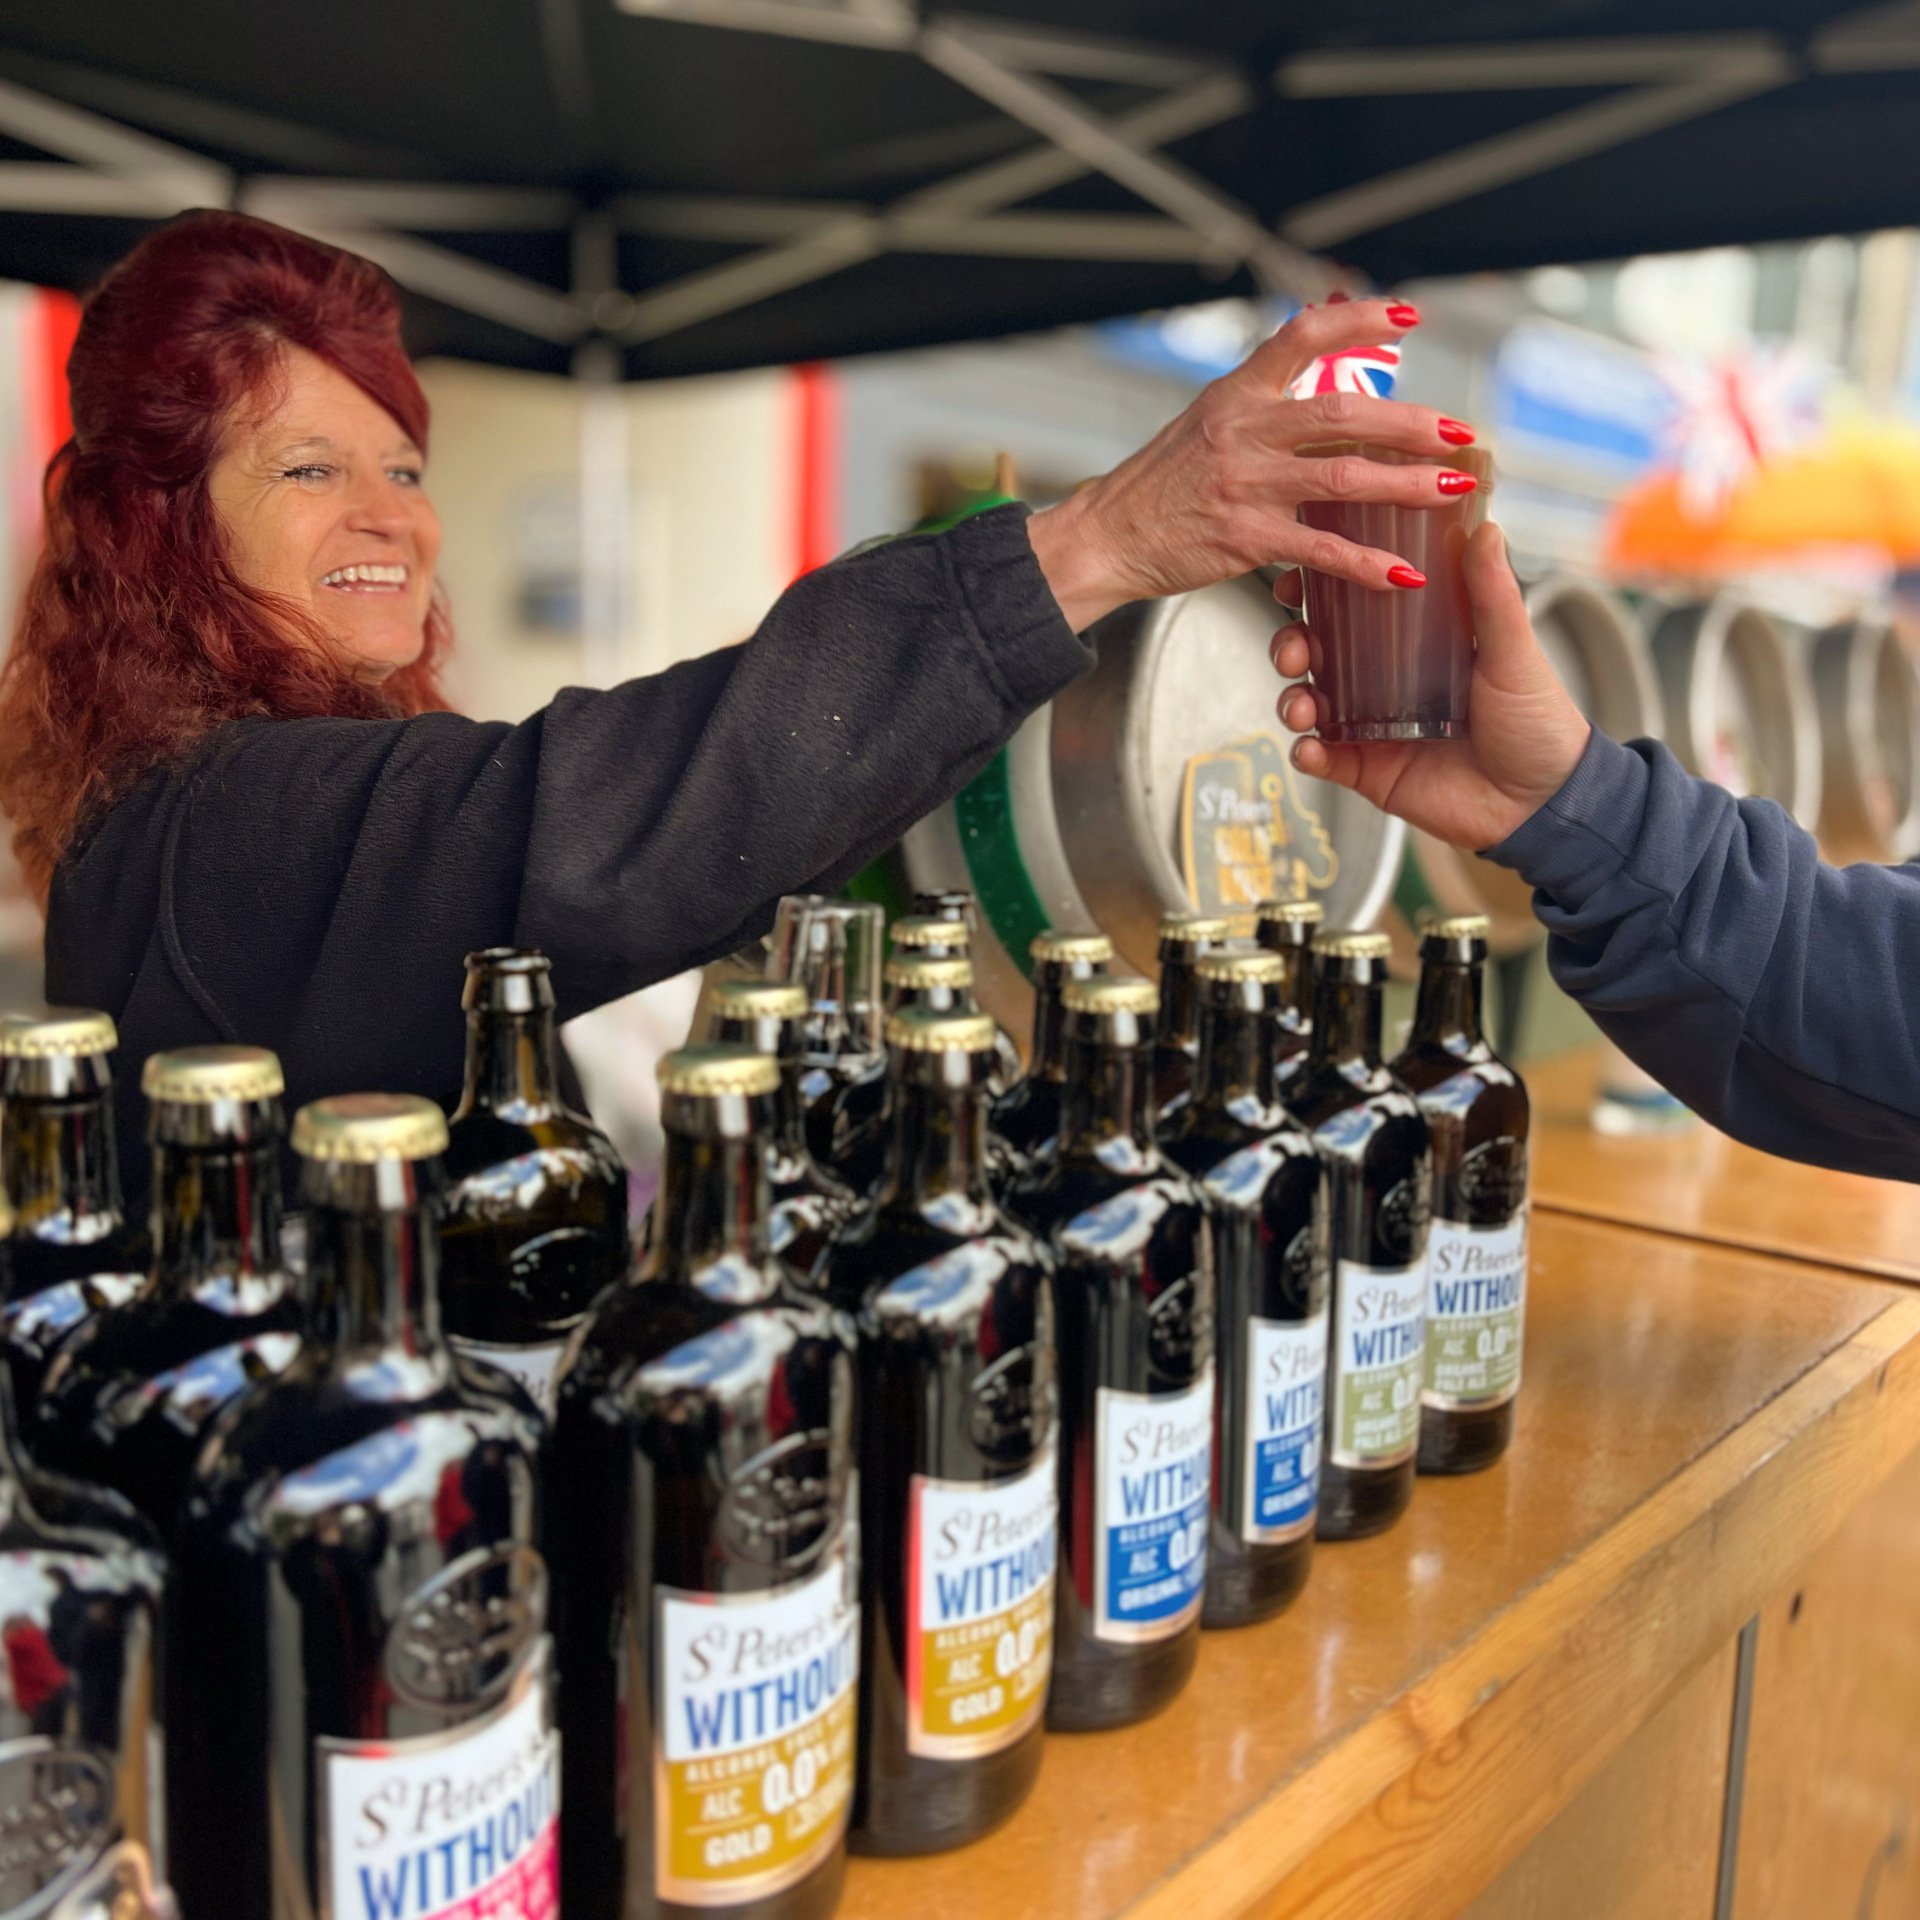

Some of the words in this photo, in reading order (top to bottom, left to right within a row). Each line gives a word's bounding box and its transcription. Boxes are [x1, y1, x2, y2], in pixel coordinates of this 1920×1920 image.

[1434, 1273, 1520, 1315] WITHOU
[1266, 1376, 1324, 1432] WITH
[936, 1528, 1055, 1619] WITHOU
[1129, 1548, 1159, 1575] ALC
[949, 1654, 982, 1683] ALC
[684, 1640, 852, 1749] WITHOU
[950, 1685, 1005, 1726] GOLD
[685, 1743, 780, 1782] ALCOHOL
[703, 1787, 743, 1821] ALC
[358, 1763, 551, 1920] WITHOU
[704, 1823, 773, 1867] GOLD
